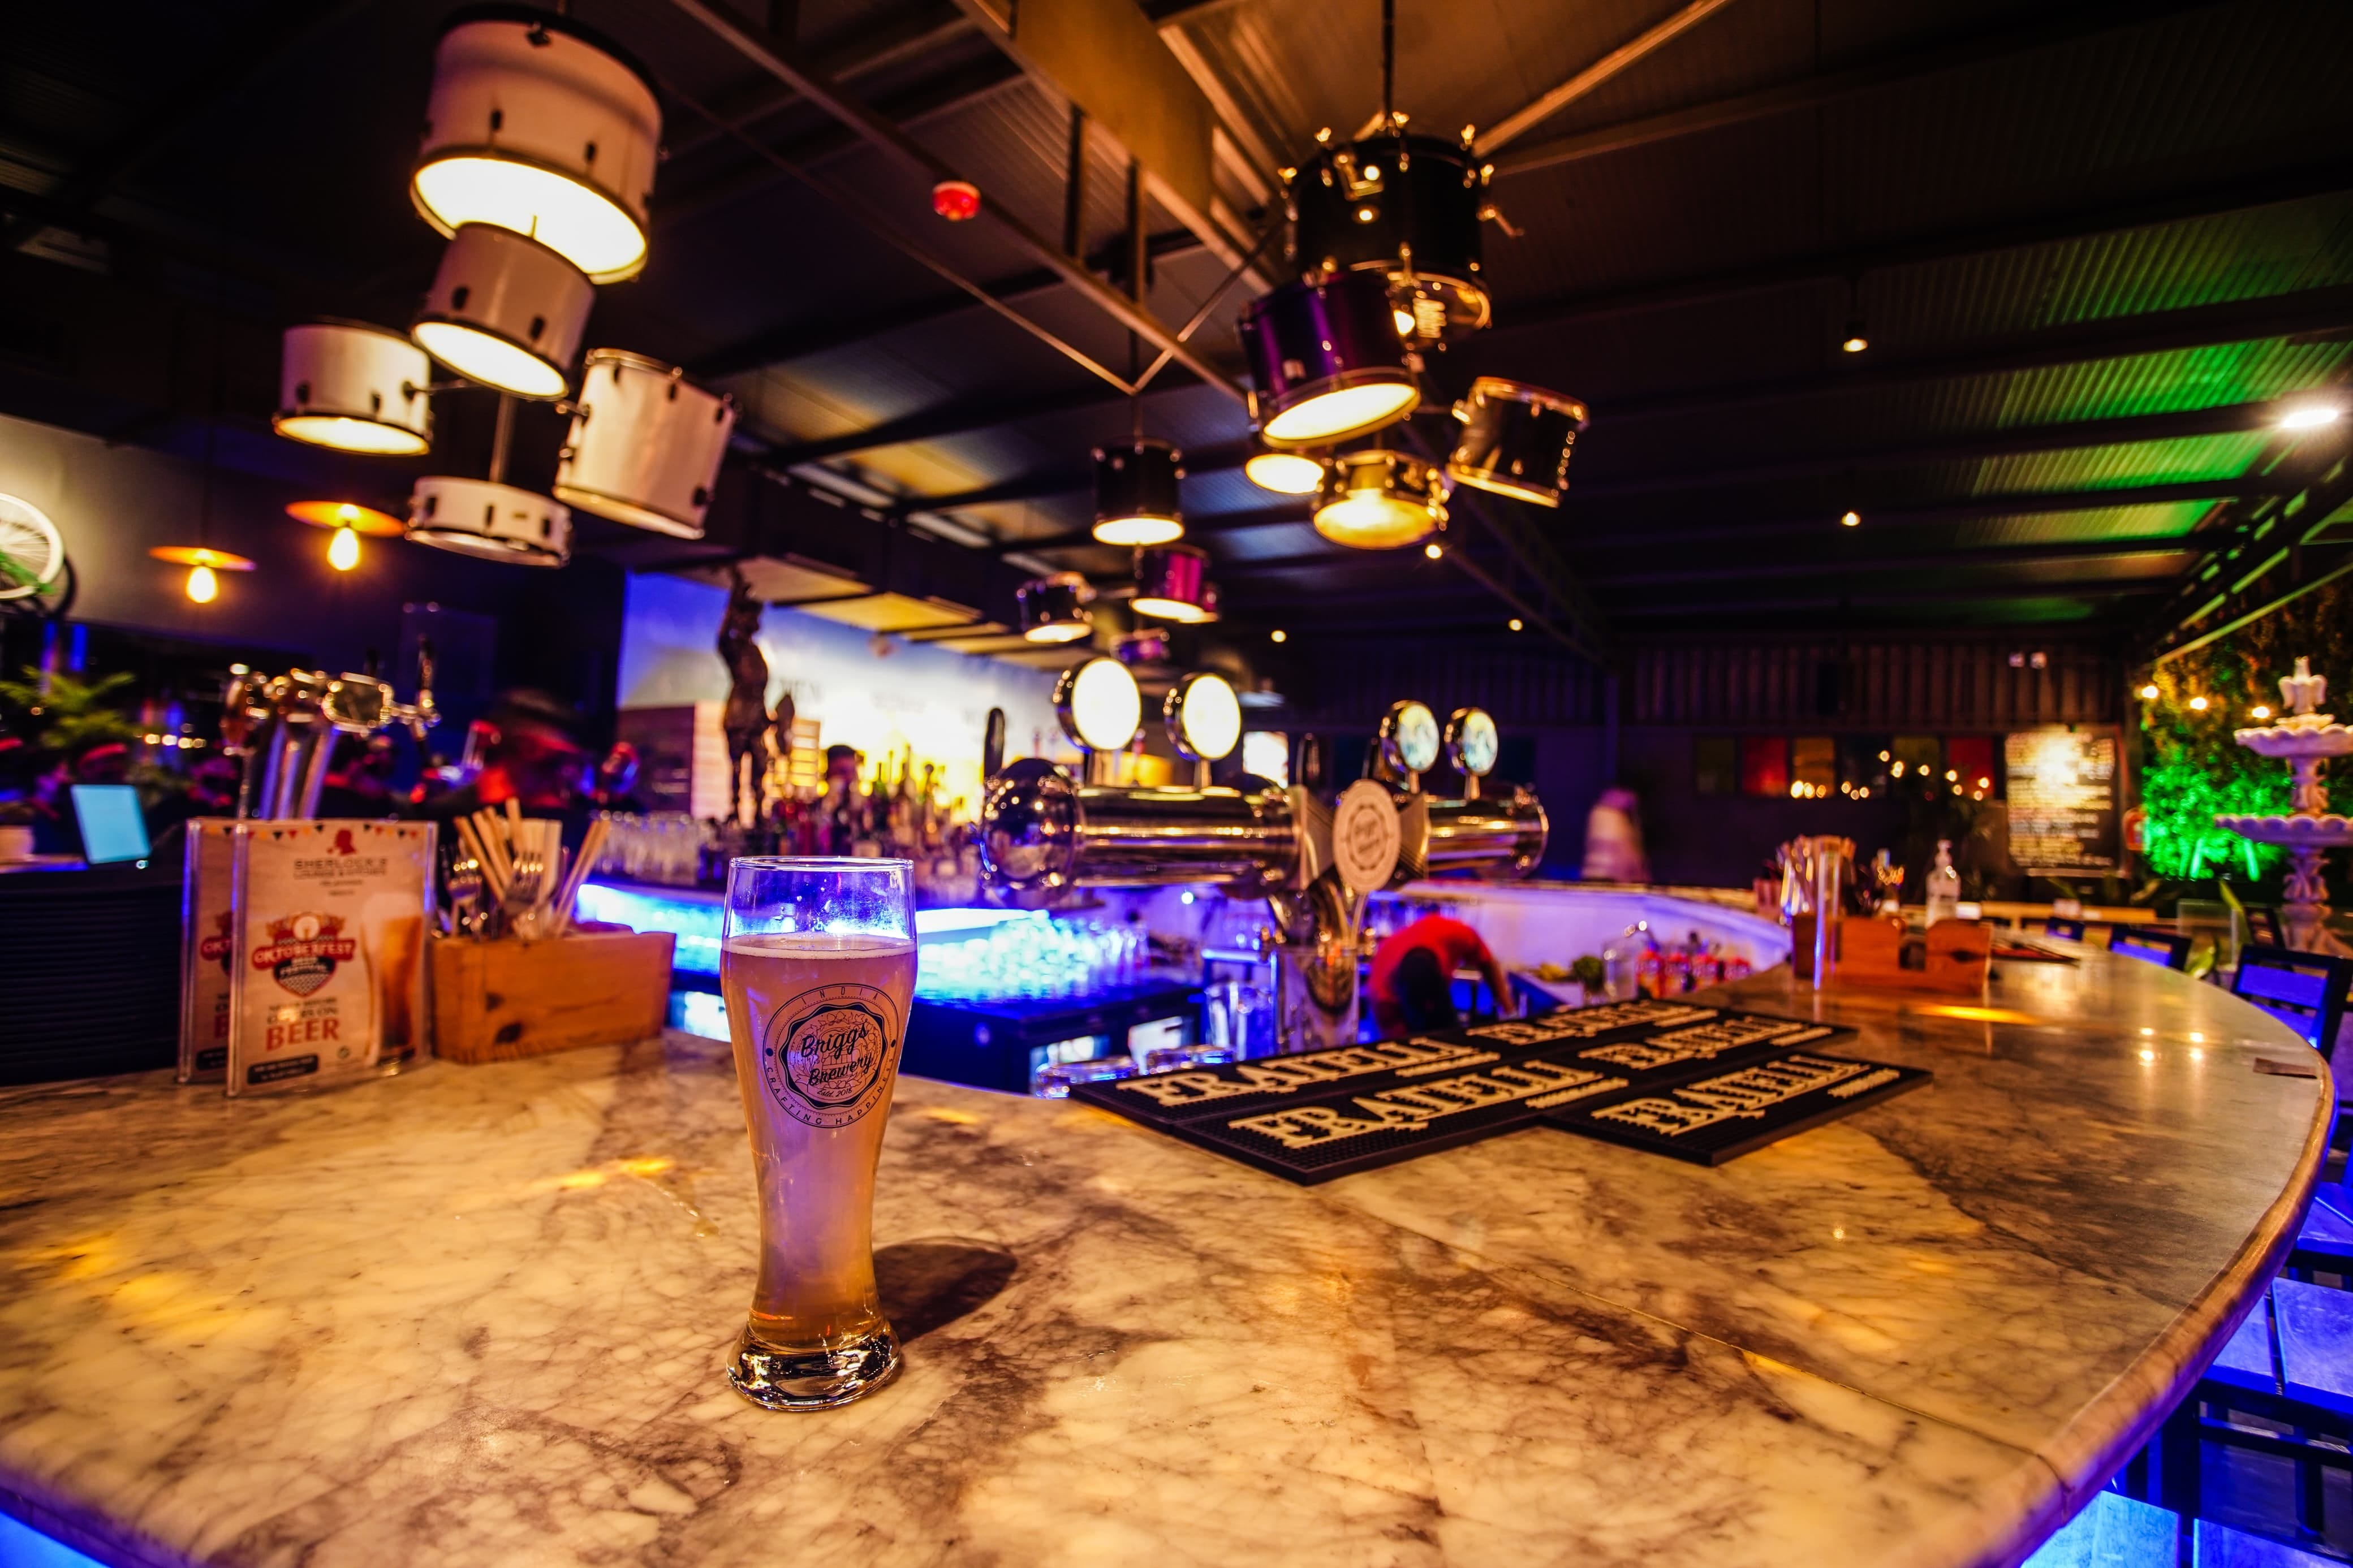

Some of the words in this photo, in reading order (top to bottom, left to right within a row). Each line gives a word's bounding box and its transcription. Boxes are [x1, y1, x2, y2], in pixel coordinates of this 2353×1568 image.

[253, 943, 352, 964] OKTOBERFEST
[802, 987, 880, 1005] INDIA
[266, 1017, 340, 1052] BEER
[801, 1018, 869, 1060] Briggs
[808, 1052, 873, 1086] Brewery
[1116, 1038, 1480, 1107] FRATELLI
[767, 1066, 824, 1125] CRAFTING
[835, 1058, 894, 1125] HAPPINESS
[835, 1087, 852, 1098] 2018
[1229, 1059, 1604, 1149] FRATELLI
